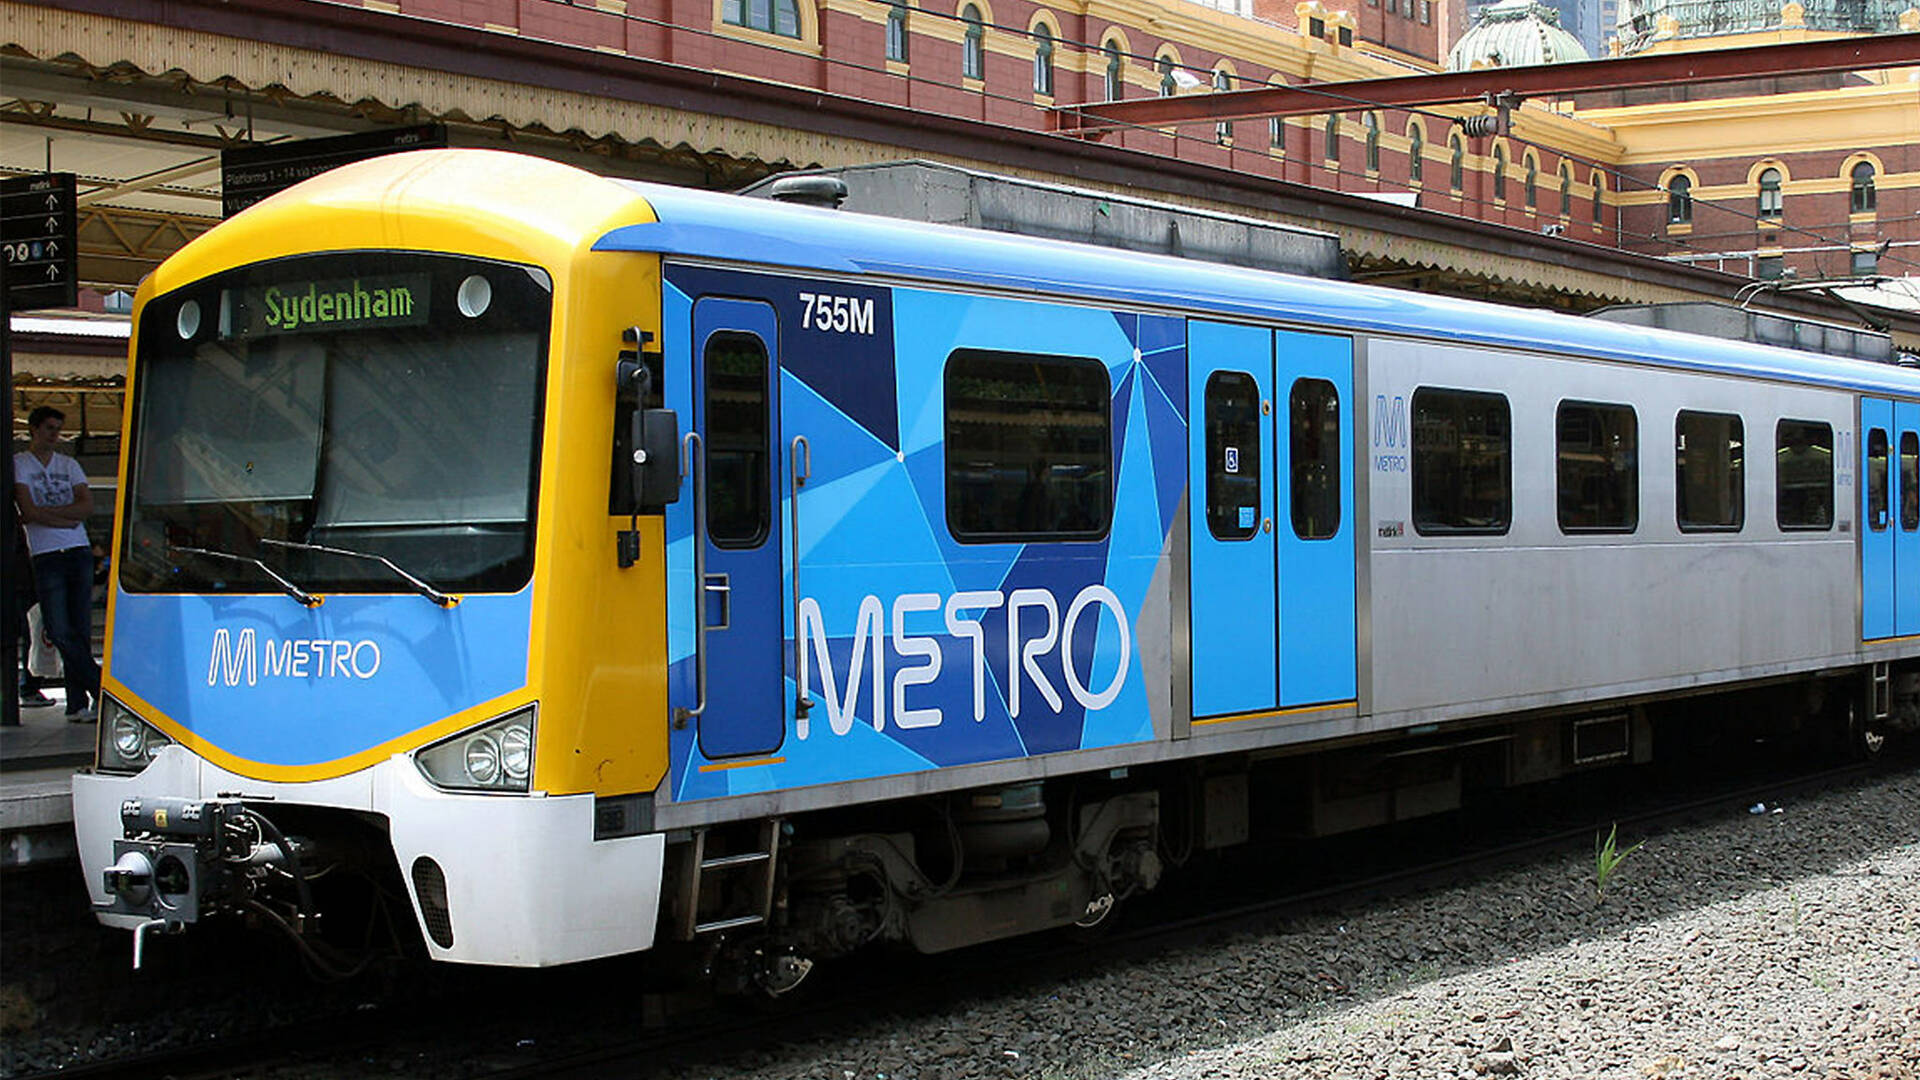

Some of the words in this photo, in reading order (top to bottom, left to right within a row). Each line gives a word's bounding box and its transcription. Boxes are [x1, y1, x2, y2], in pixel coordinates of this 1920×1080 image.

[225, 173, 267, 186] Platforms
[265, 280, 411, 329] Sydenham
[799, 292, 875, 335] 755M
[1374, 455, 1407, 472] METRO
[264, 639, 380, 679] METRO
[796, 584, 1131, 740] METRO
